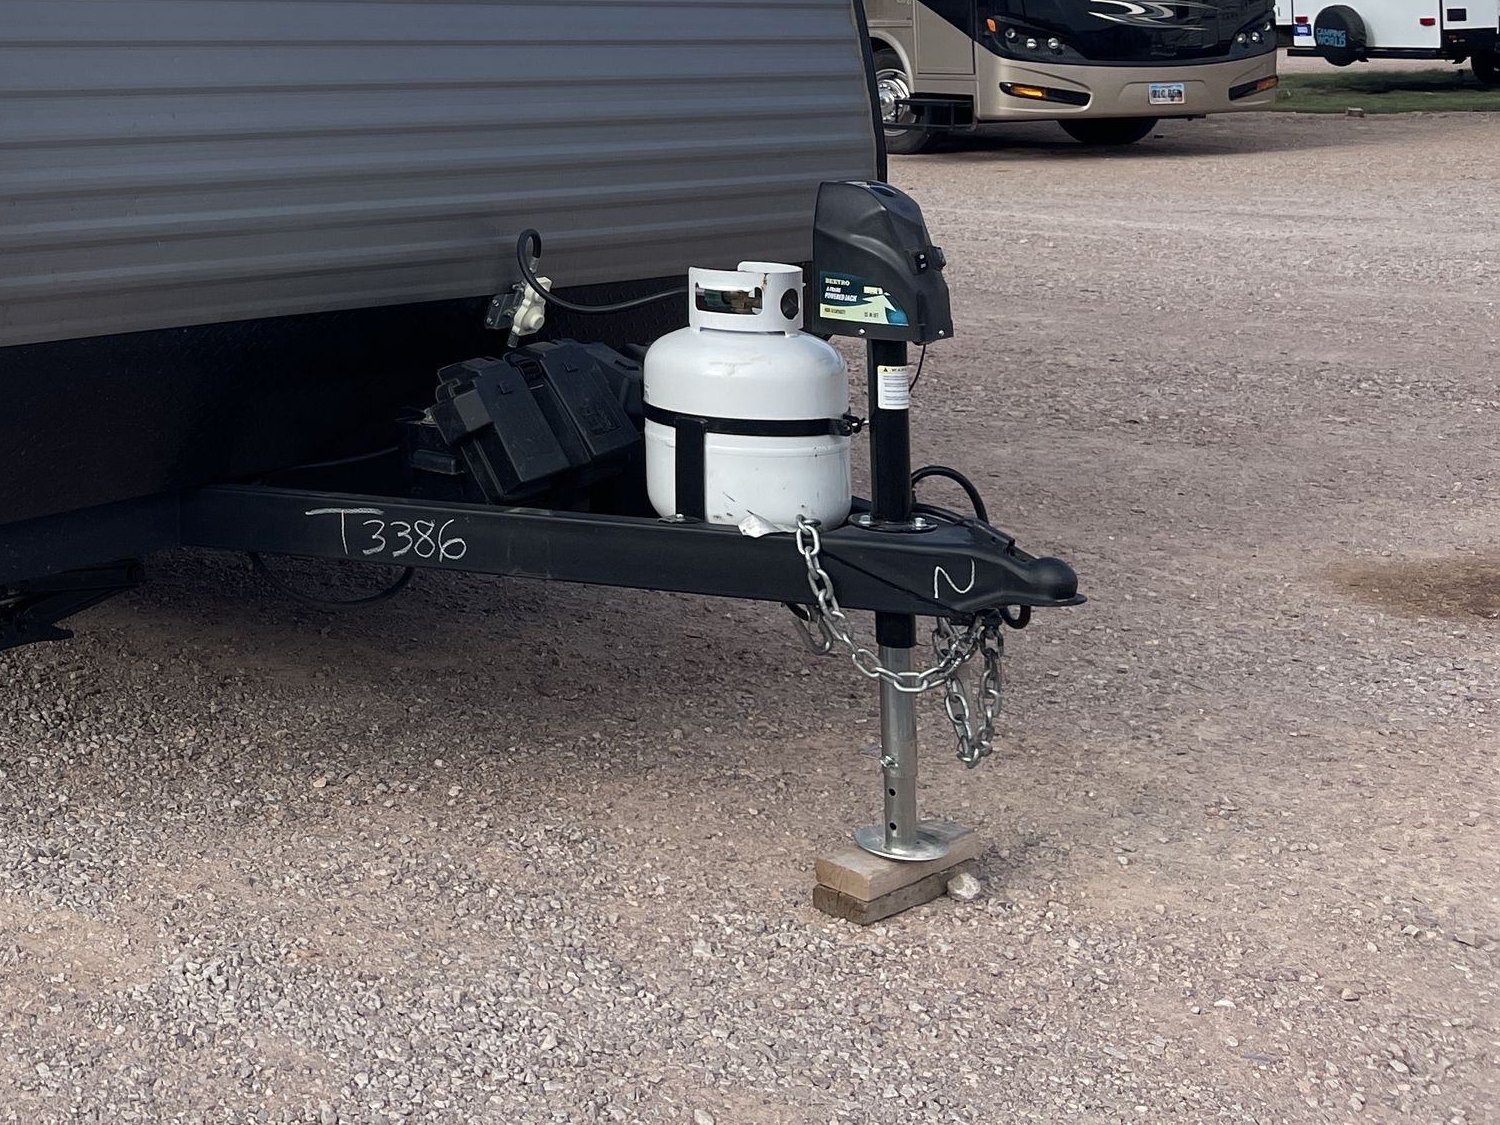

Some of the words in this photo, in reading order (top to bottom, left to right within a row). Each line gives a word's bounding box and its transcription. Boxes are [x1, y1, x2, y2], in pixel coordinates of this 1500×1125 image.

[1316, 27, 1346, 38] CAMPING
[1317, 35, 1346, 47] WORLD
[305, 507, 467, 563] T3386
